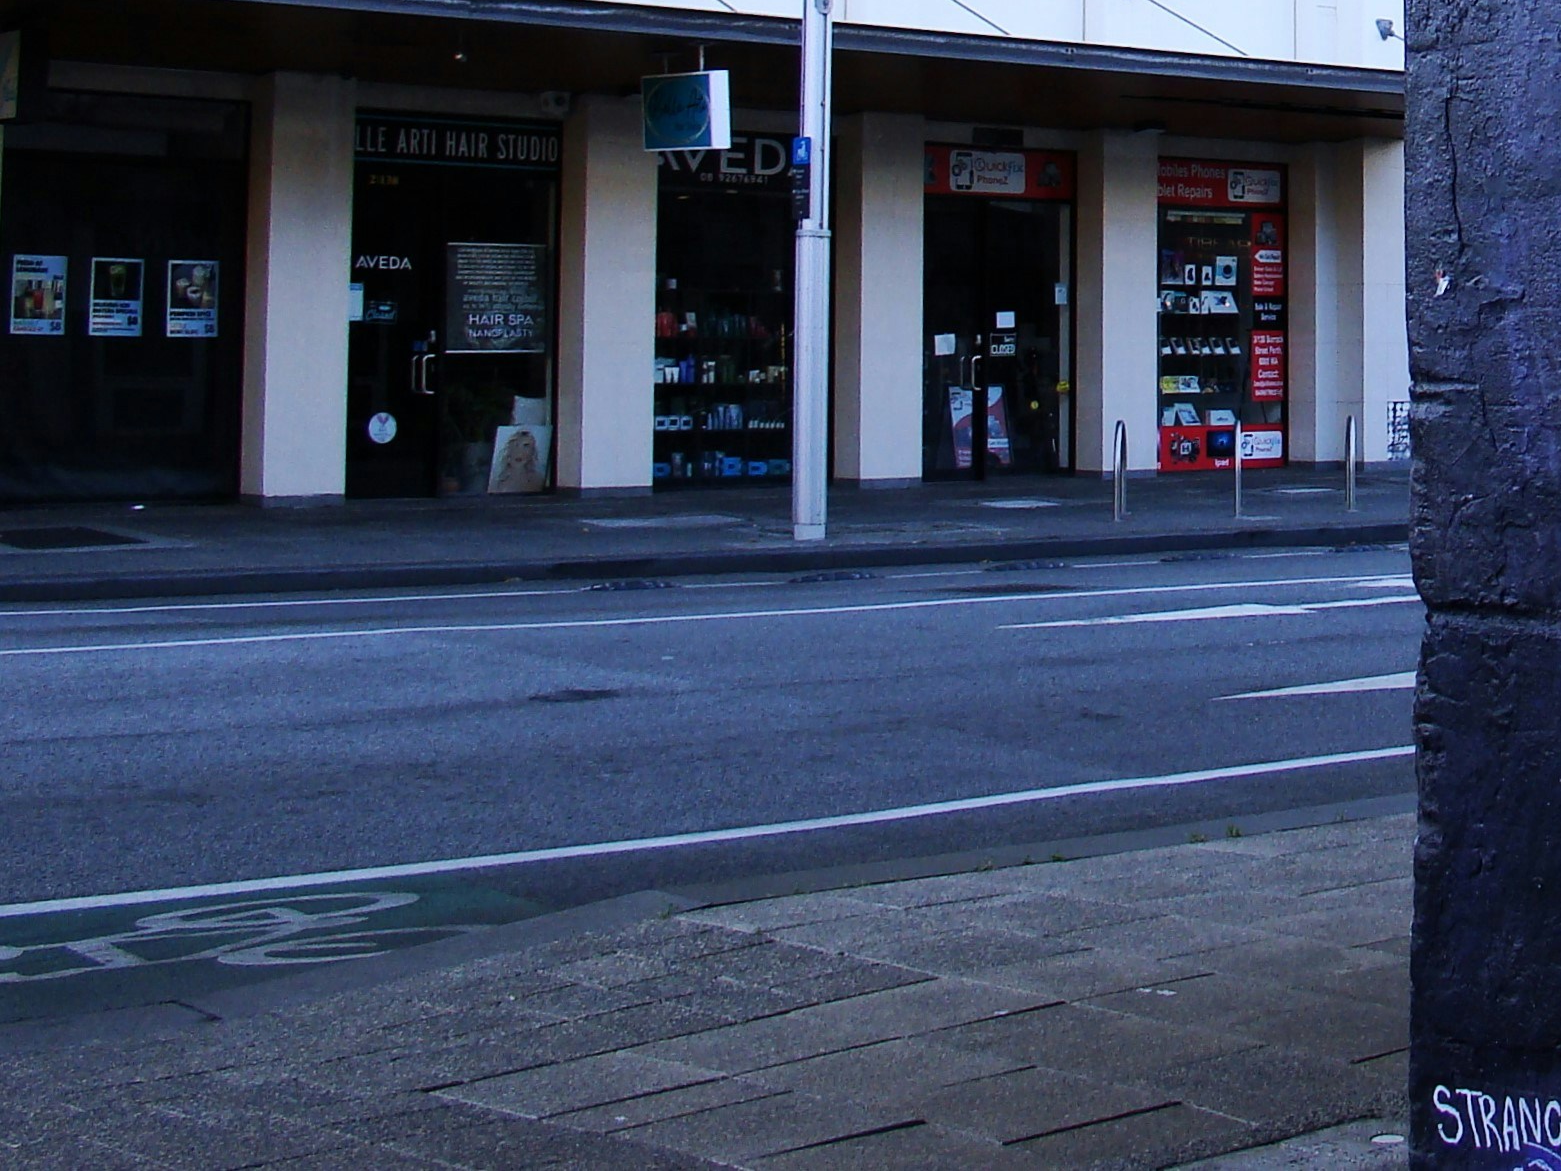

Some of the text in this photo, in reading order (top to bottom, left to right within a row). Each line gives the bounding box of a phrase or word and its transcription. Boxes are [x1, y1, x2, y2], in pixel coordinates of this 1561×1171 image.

[396, 127, 437, 156] ARTI
[445, 130, 489, 159] HAIR
[496, 133, 559, 162] STUDIO
[658, 136, 795, 177] AVED
[1191, 164, 1226, 180] Phones
[1177, 183, 1214, 200] Repairs
[354, 254, 413, 270] AVEDA
[468, 313, 535, 326] HAIR SPA
